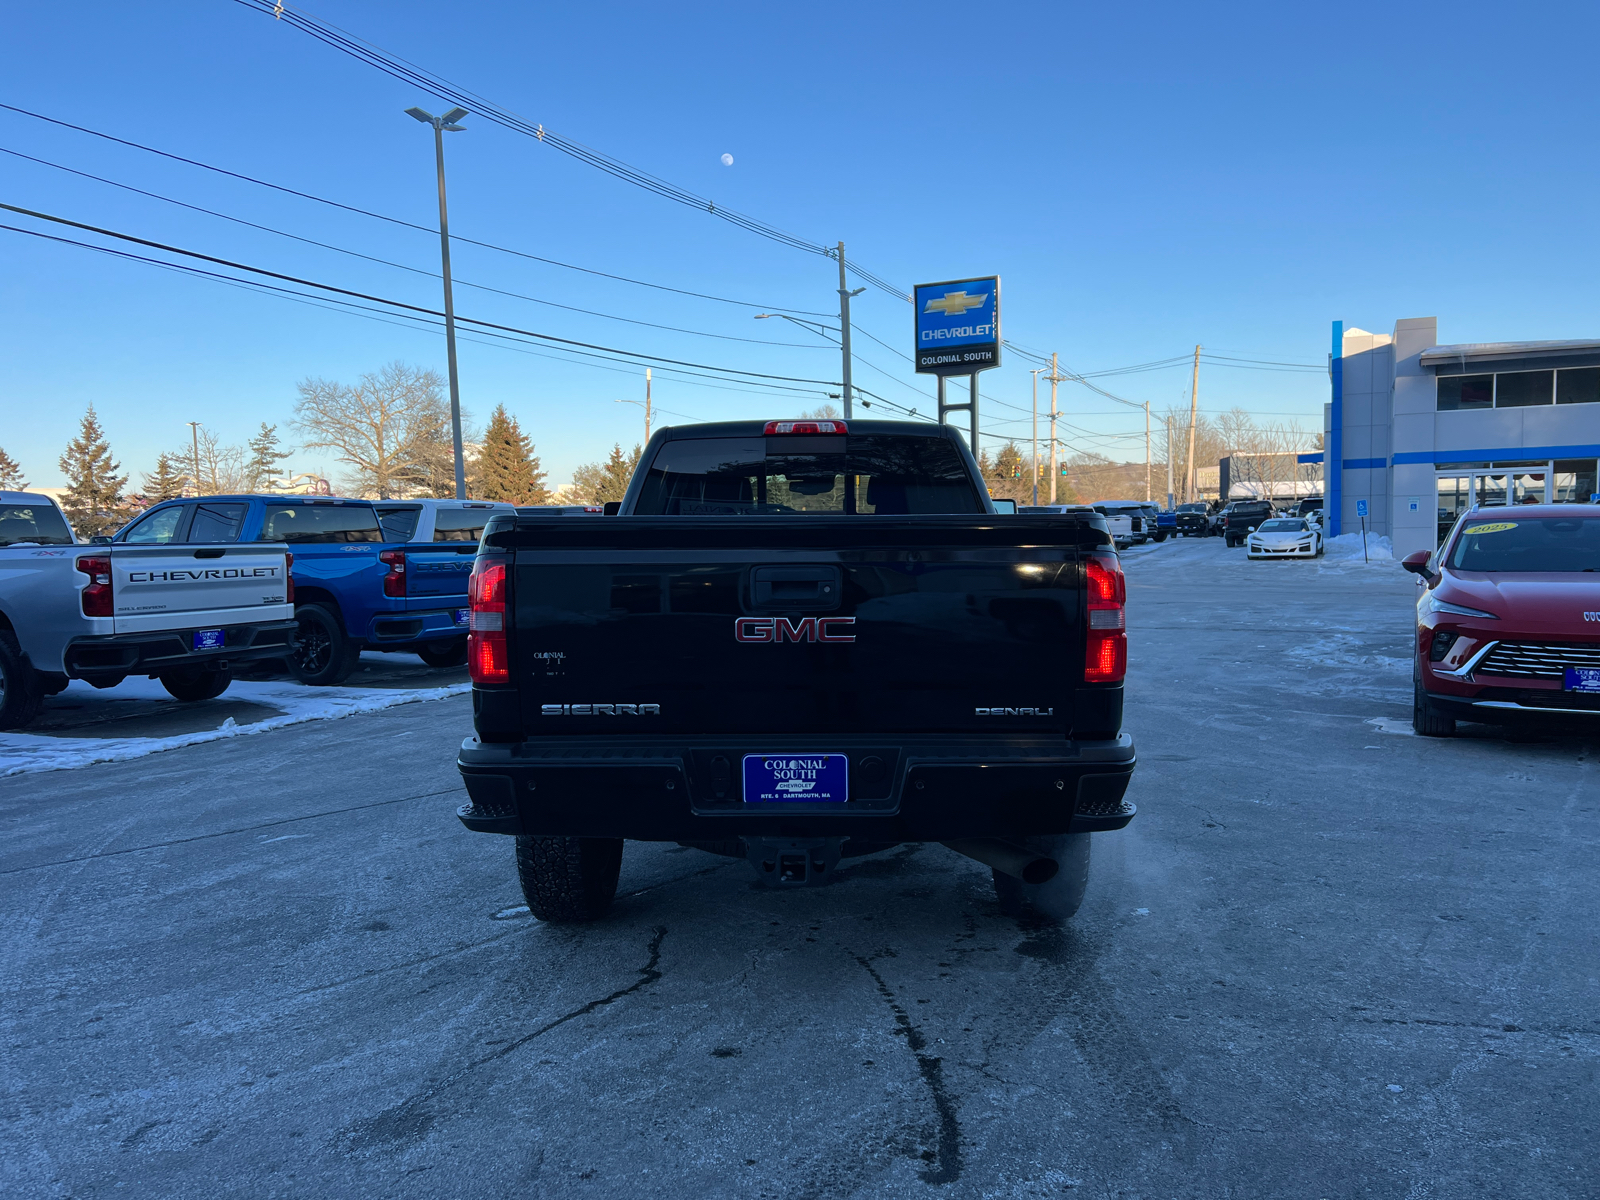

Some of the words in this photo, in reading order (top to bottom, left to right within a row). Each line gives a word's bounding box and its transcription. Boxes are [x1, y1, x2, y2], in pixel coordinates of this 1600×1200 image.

[922, 324, 991, 341] CHEVROLET
[921, 354, 961, 365] COLONIAL
[964, 352, 992, 361] SOUTH
[1472, 524, 1508, 533] 2025
[129, 568, 278, 583] CHEVROLET
[734, 617, 856, 643] GMC
[541, 703, 661, 716] SIERRA
[975, 707, 1054, 716] DENALI
[764, 760, 827, 770] COLONIAL
[774, 769, 817, 779] SOUTH
